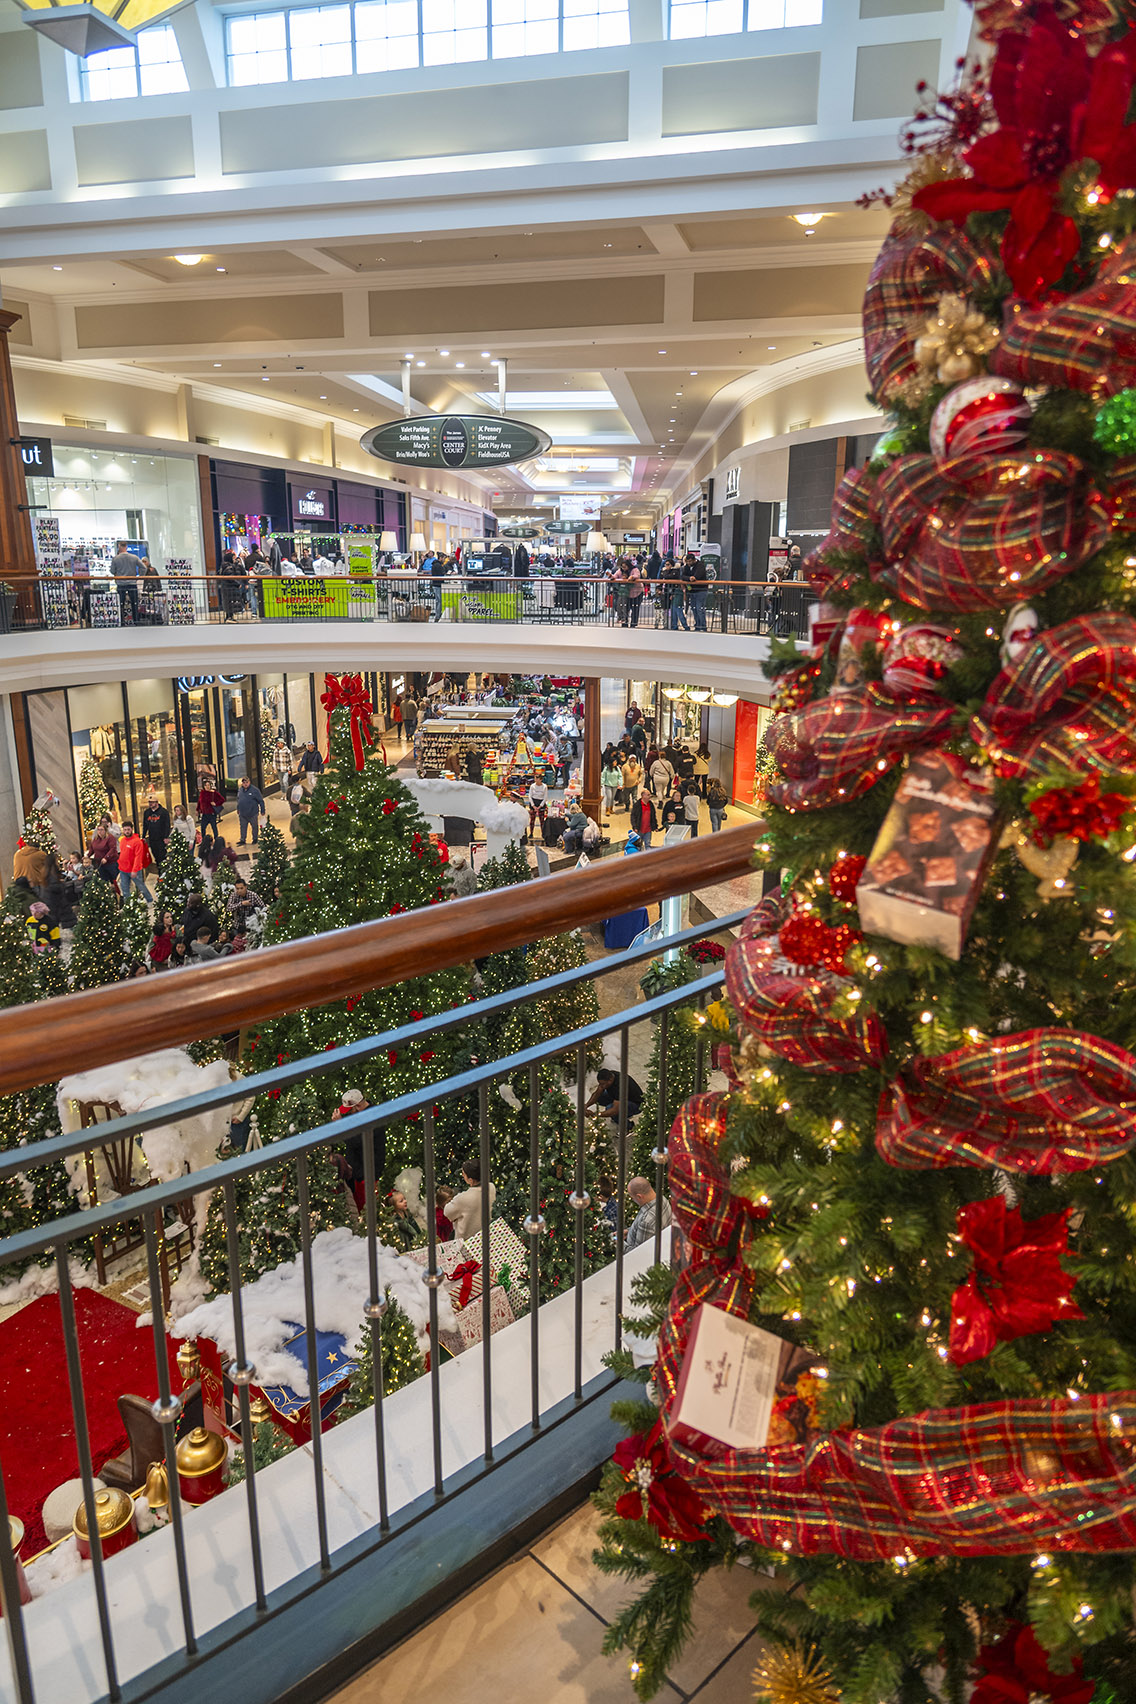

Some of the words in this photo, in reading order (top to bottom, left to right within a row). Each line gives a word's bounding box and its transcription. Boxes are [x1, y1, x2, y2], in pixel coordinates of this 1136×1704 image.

[413, 426, 430, 434] Parking
[484, 426, 502, 434] Penney
[413, 442, 430, 450] Macy's
[281, 588, 327, 596] T-SHIRTS
